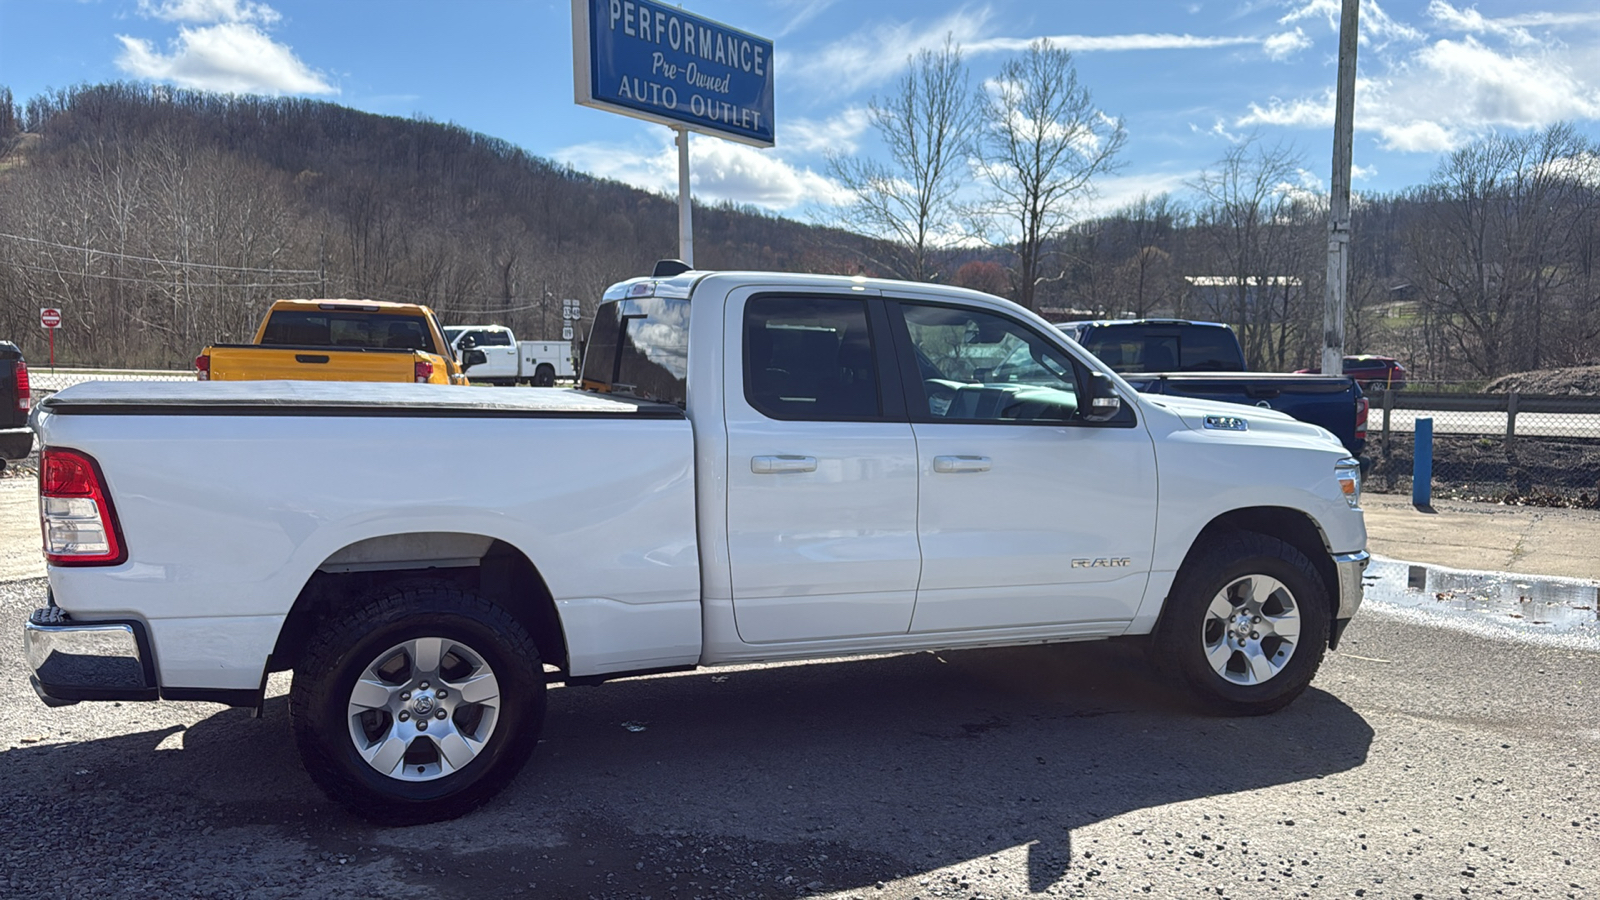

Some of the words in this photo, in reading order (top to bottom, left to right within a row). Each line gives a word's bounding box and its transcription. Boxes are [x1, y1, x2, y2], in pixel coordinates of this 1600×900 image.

[609, 0, 764, 76] PERFORMANCE
[652, 52, 731, 94] Pre-Owned
[618, 75, 678, 110] AUTO
[690, 94, 761, 131] OUTLET
[1071, 557, 1131, 569] RAM
